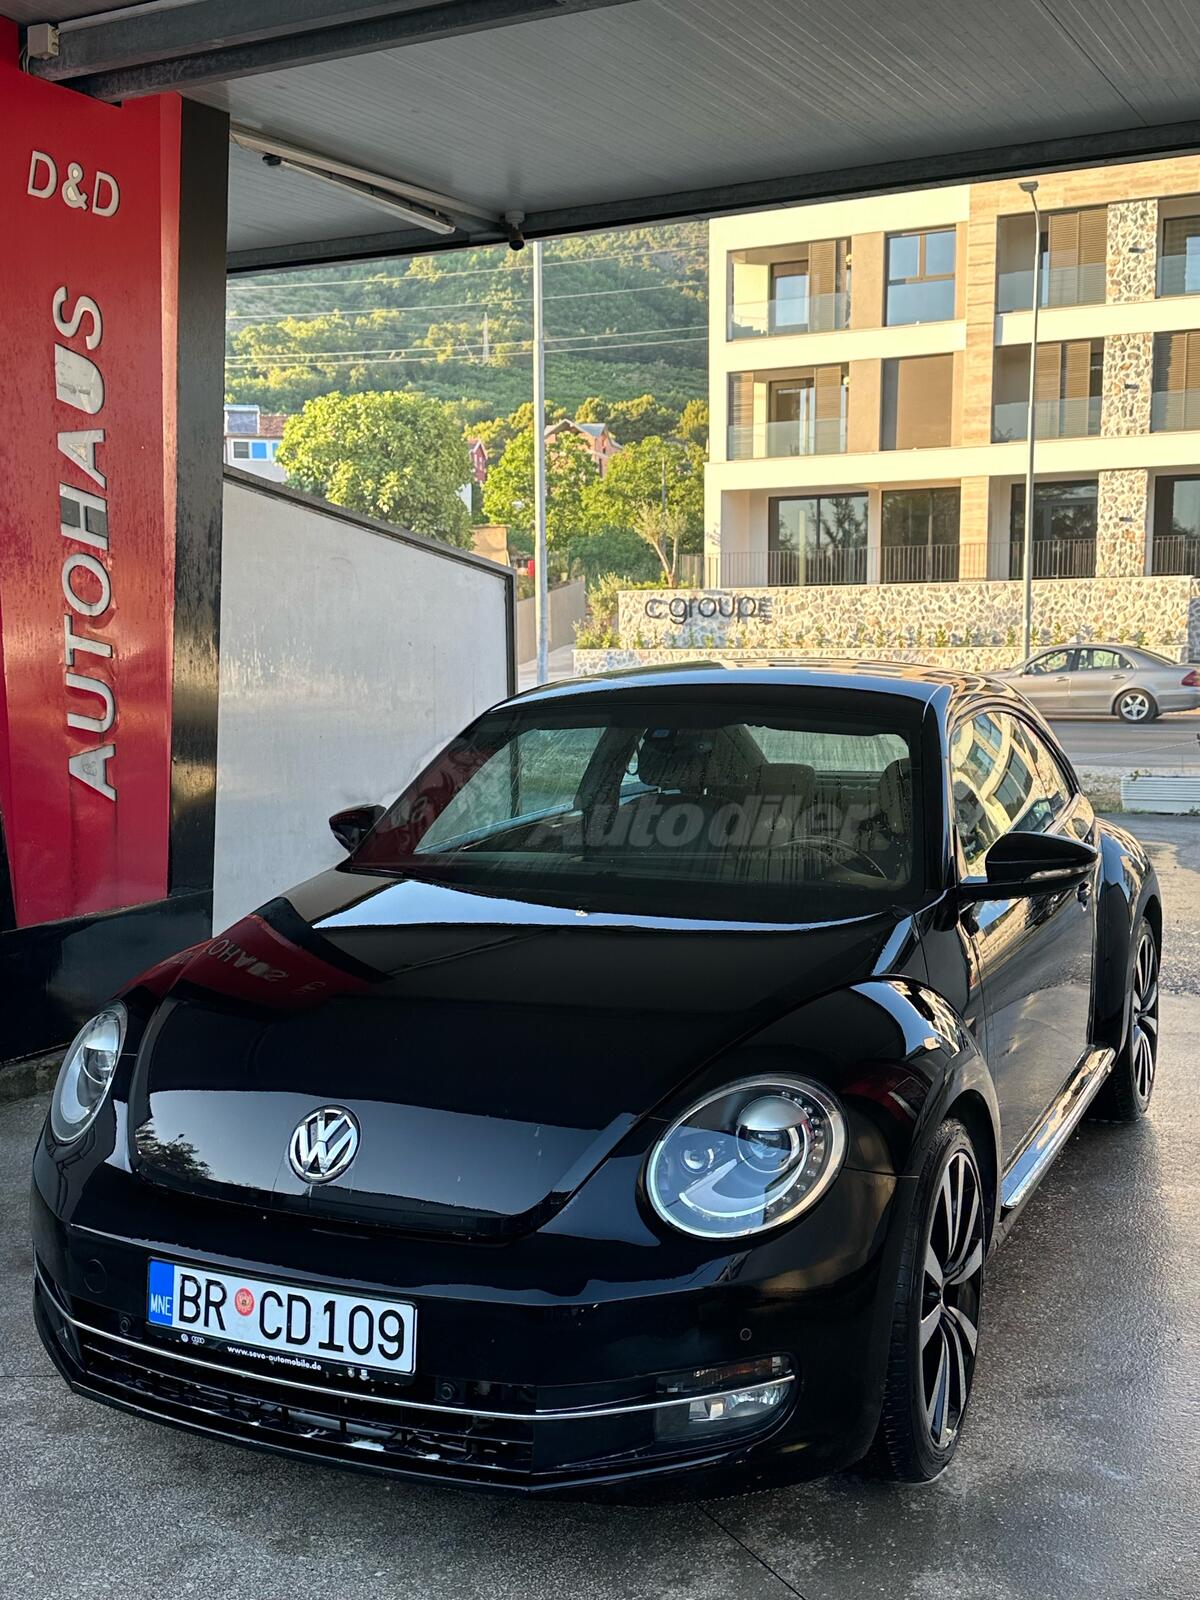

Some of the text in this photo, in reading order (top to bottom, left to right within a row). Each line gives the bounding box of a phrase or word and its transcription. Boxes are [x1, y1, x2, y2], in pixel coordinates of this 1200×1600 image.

[27, 150, 120, 217] D&D
[53, 286, 117, 801] AUTOHAUS
[150, 1293, 173, 1317] MNE
[178, 1273, 405, 1361] BR CD109
